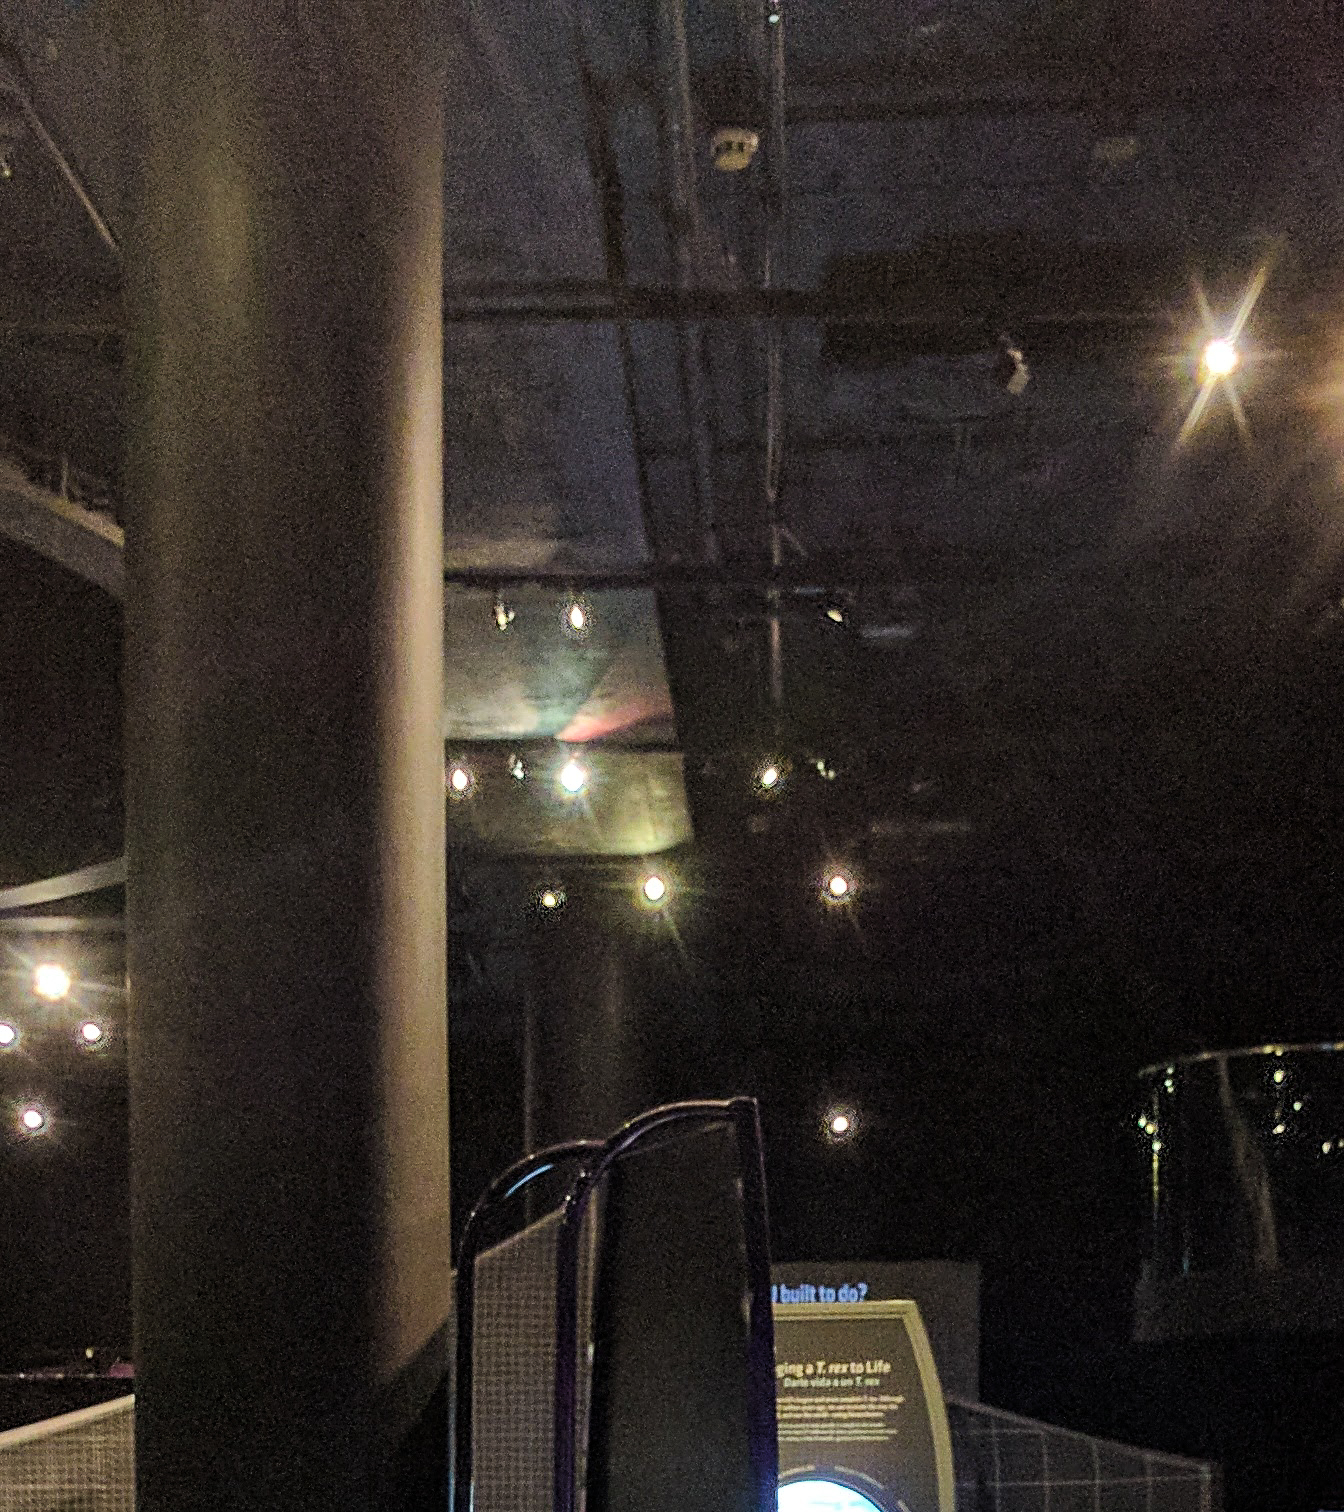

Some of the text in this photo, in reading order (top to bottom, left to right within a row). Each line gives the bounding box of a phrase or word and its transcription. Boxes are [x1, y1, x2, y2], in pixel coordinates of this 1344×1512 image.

[780, 1284, 816, 1302] built
[818, 1285, 836, 1302] to
[838, 1282, 868, 1302] do?
[850, 1362, 864, 1374] to
[866, 1360, 891, 1374] Life
